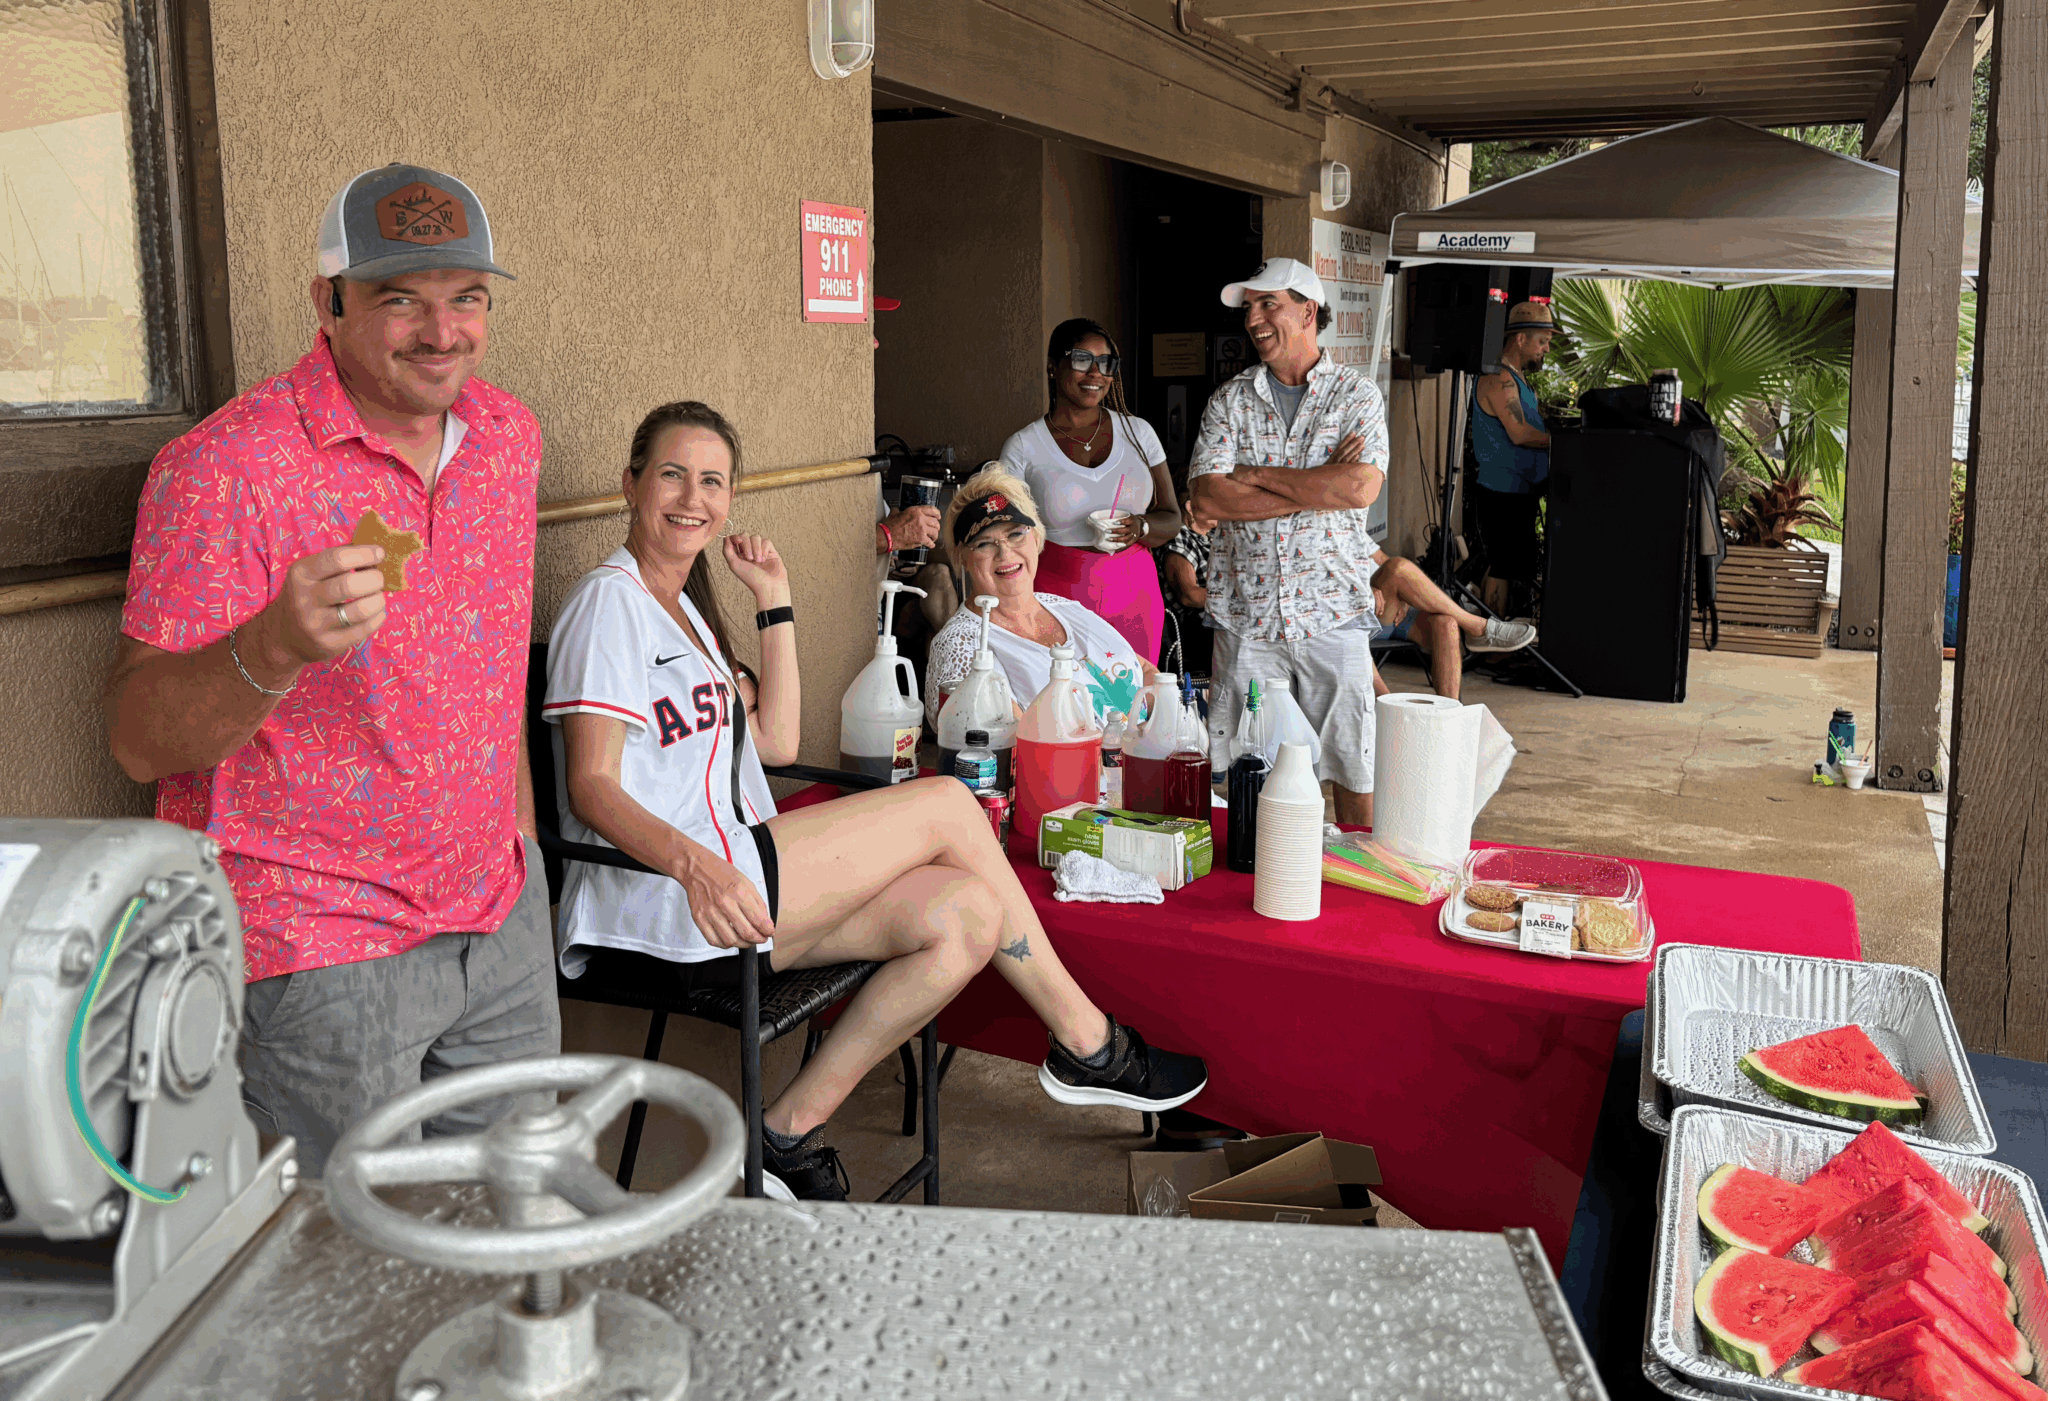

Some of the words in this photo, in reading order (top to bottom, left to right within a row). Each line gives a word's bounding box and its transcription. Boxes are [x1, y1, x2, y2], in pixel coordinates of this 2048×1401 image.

[439, 210, 453, 223] W
[805, 212, 863, 237] EMERGENCY
[1341, 230, 1354, 250] POOL
[1355, 233, 1371, 254] RULES
[1437, 233, 1511, 251] Academy
[820, 238, 849, 273] 911
[1314, 250, 1337, 282] Warning
[1341, 254, 1349, 279] No
[1350, 256, 1373, 285] Lifeguard
[819, 277, 853, 297] PHONE
[1337, 311, 1344, 334] NO
[1345, 311, 1363, 334] DIVING
[1525, 919, 1569, 932] BAKERY
